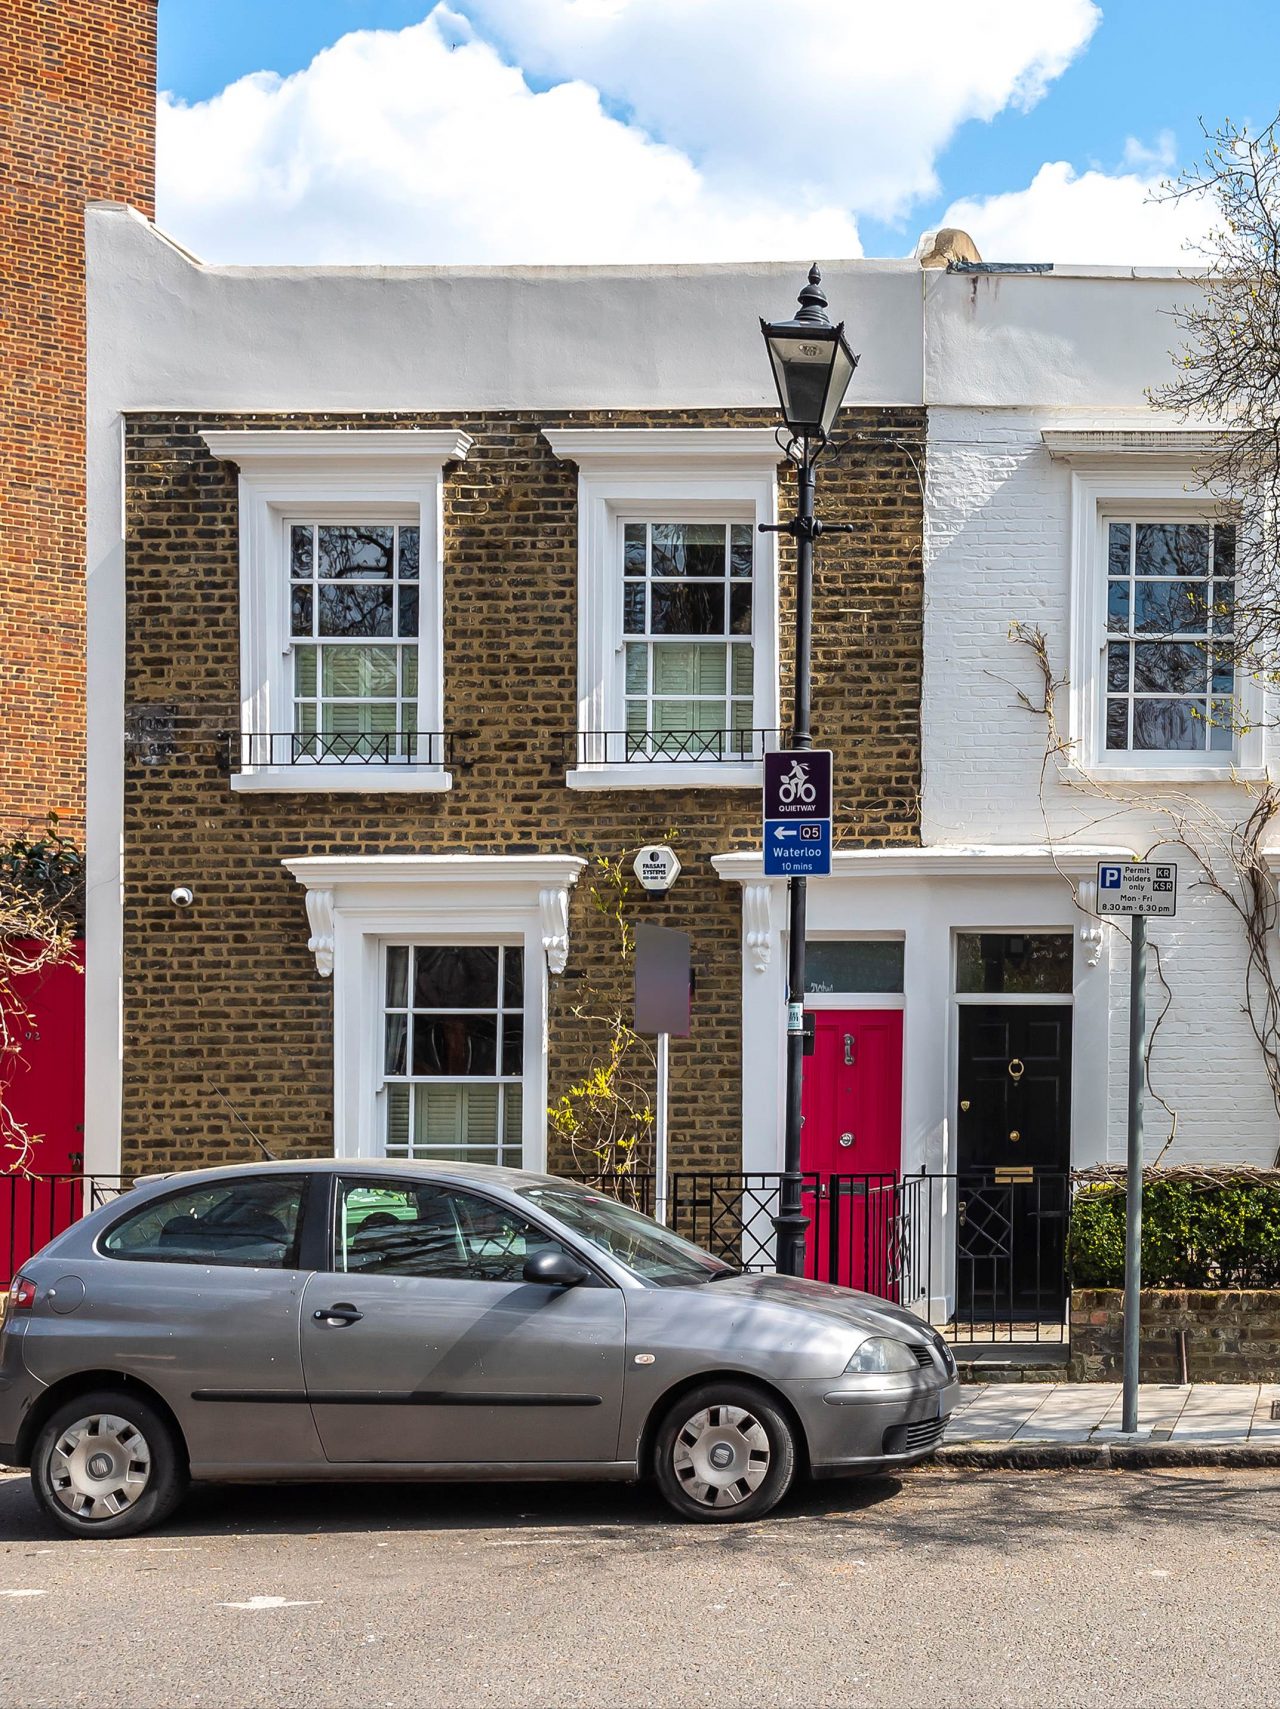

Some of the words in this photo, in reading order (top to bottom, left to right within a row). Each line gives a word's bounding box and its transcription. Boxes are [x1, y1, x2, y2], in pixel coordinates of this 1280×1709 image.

[802, 827, 819, 839] Q5
[773, 847, 822, 857] Waterloo
[1125, 866, 1150, 874] Permit
[1157, 869, 1170, 878] KR
[1105, 869, 1119, 887] P
[1153, 882, 1173, 891] KSR
[1120, 894, 1136, 902] Mon
[1102, 903, 1120, 911] 8.30
